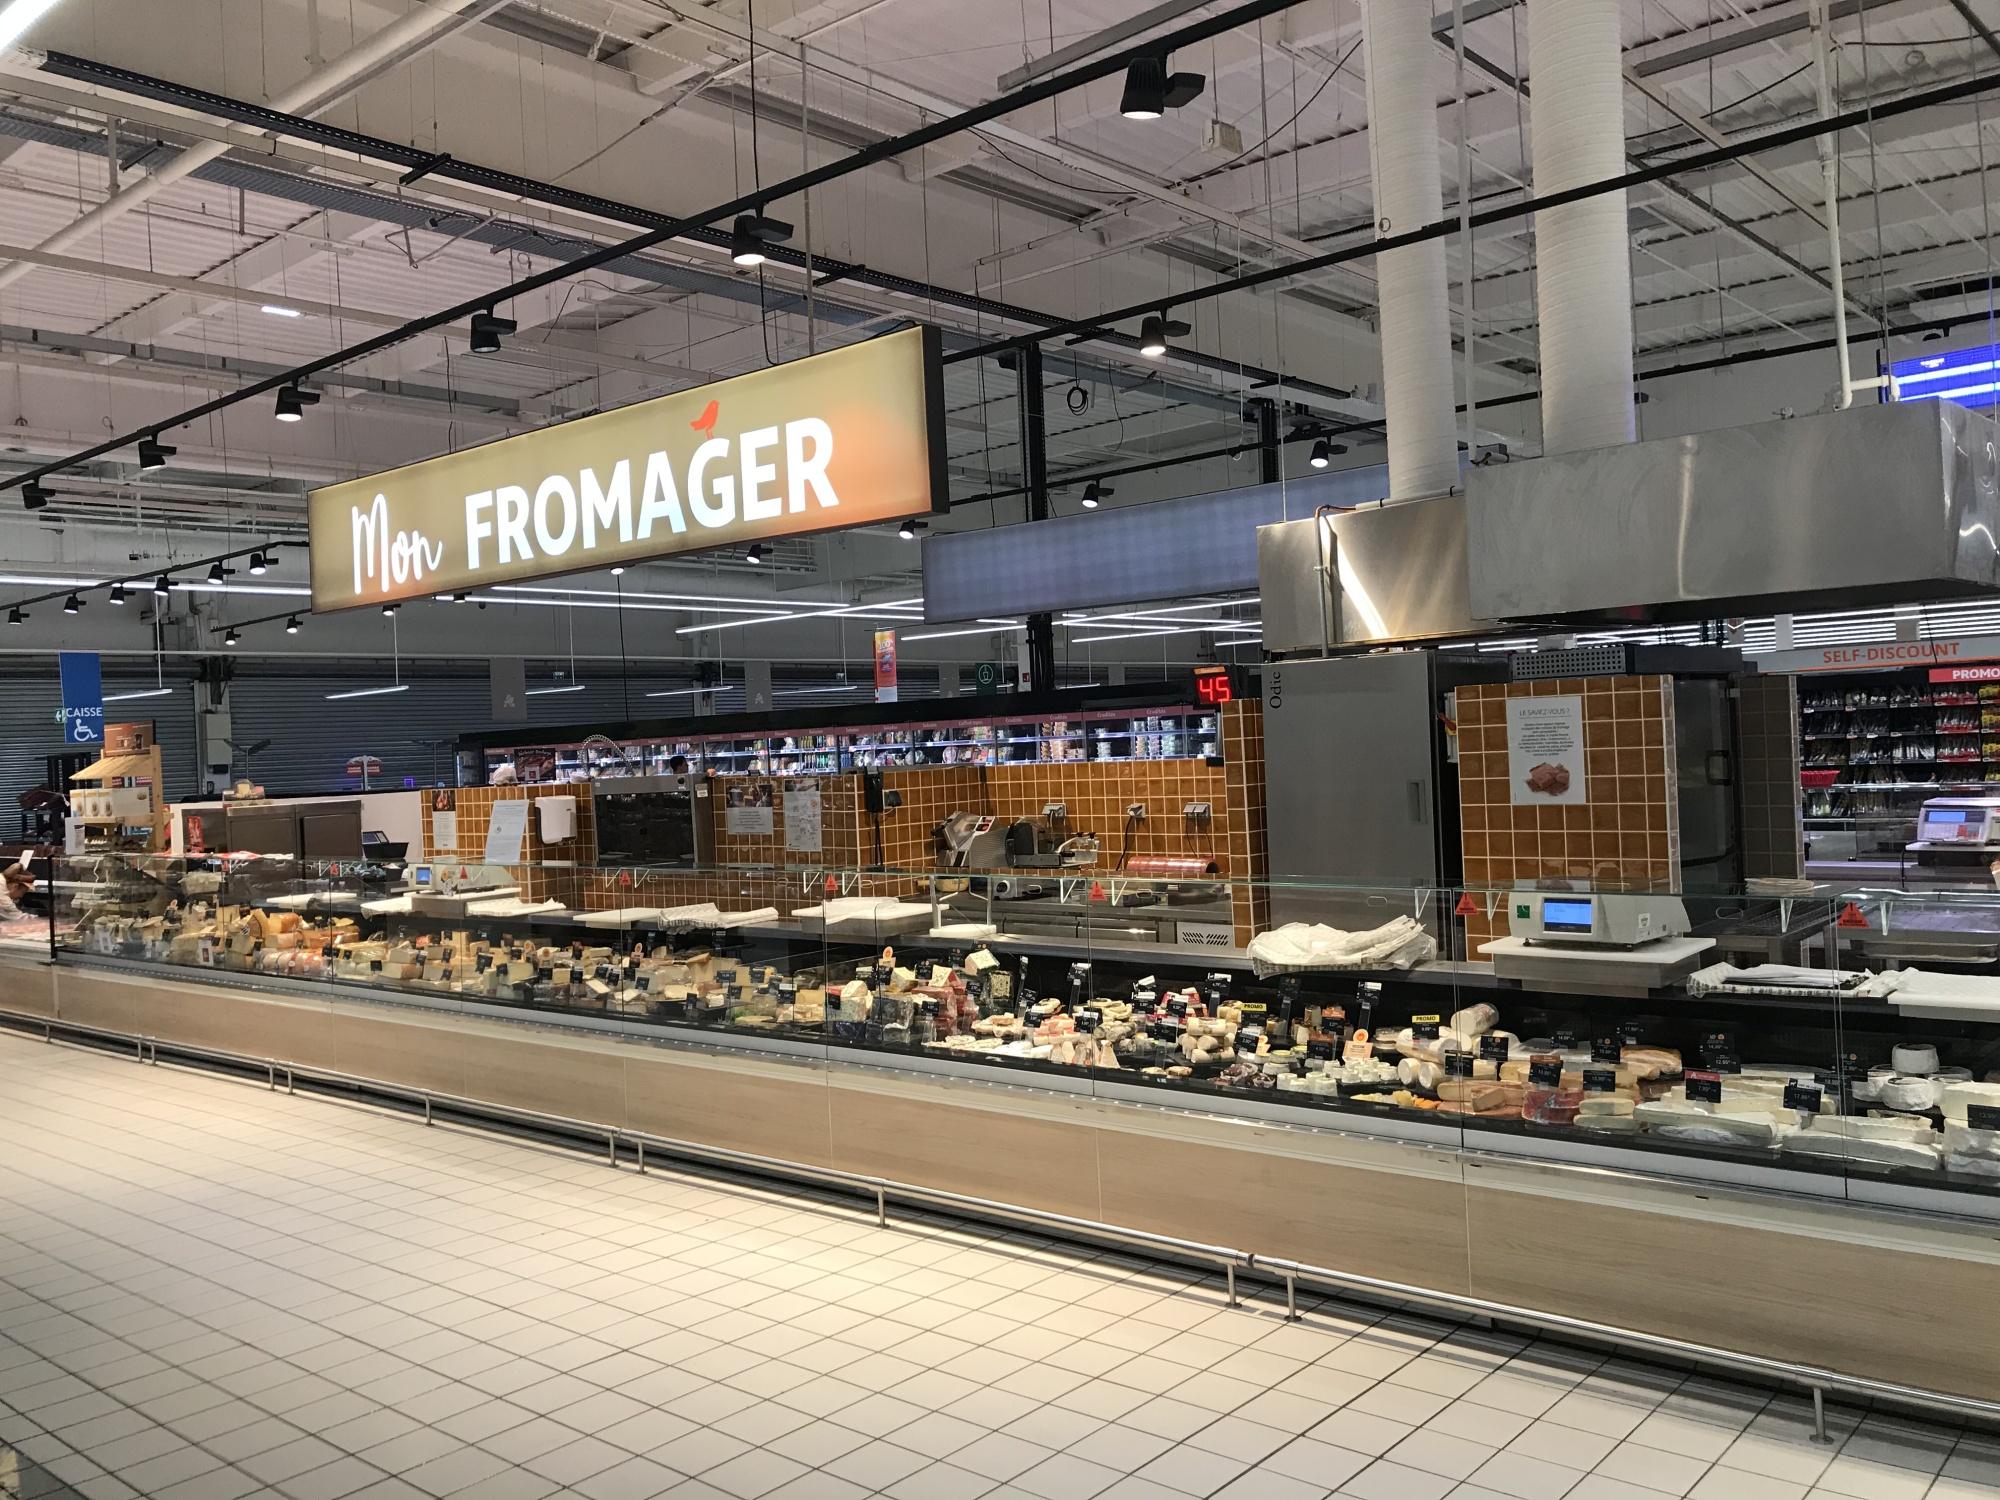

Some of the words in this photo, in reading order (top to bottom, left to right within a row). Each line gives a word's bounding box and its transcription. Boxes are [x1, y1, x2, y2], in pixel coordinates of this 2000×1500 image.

[351, 492, 443, 595] Mon
[465, 416, 840, 570] FROMAGER
[1823, 642, 1960, 663] SELF-DISCOUNT
[1952, 668, 2000, 680] PROMO
[1199, 676, 1230, 702] 45
[1269, 671, 1282, 709] Odic
[66, 707, 103, 718] CAISSE
